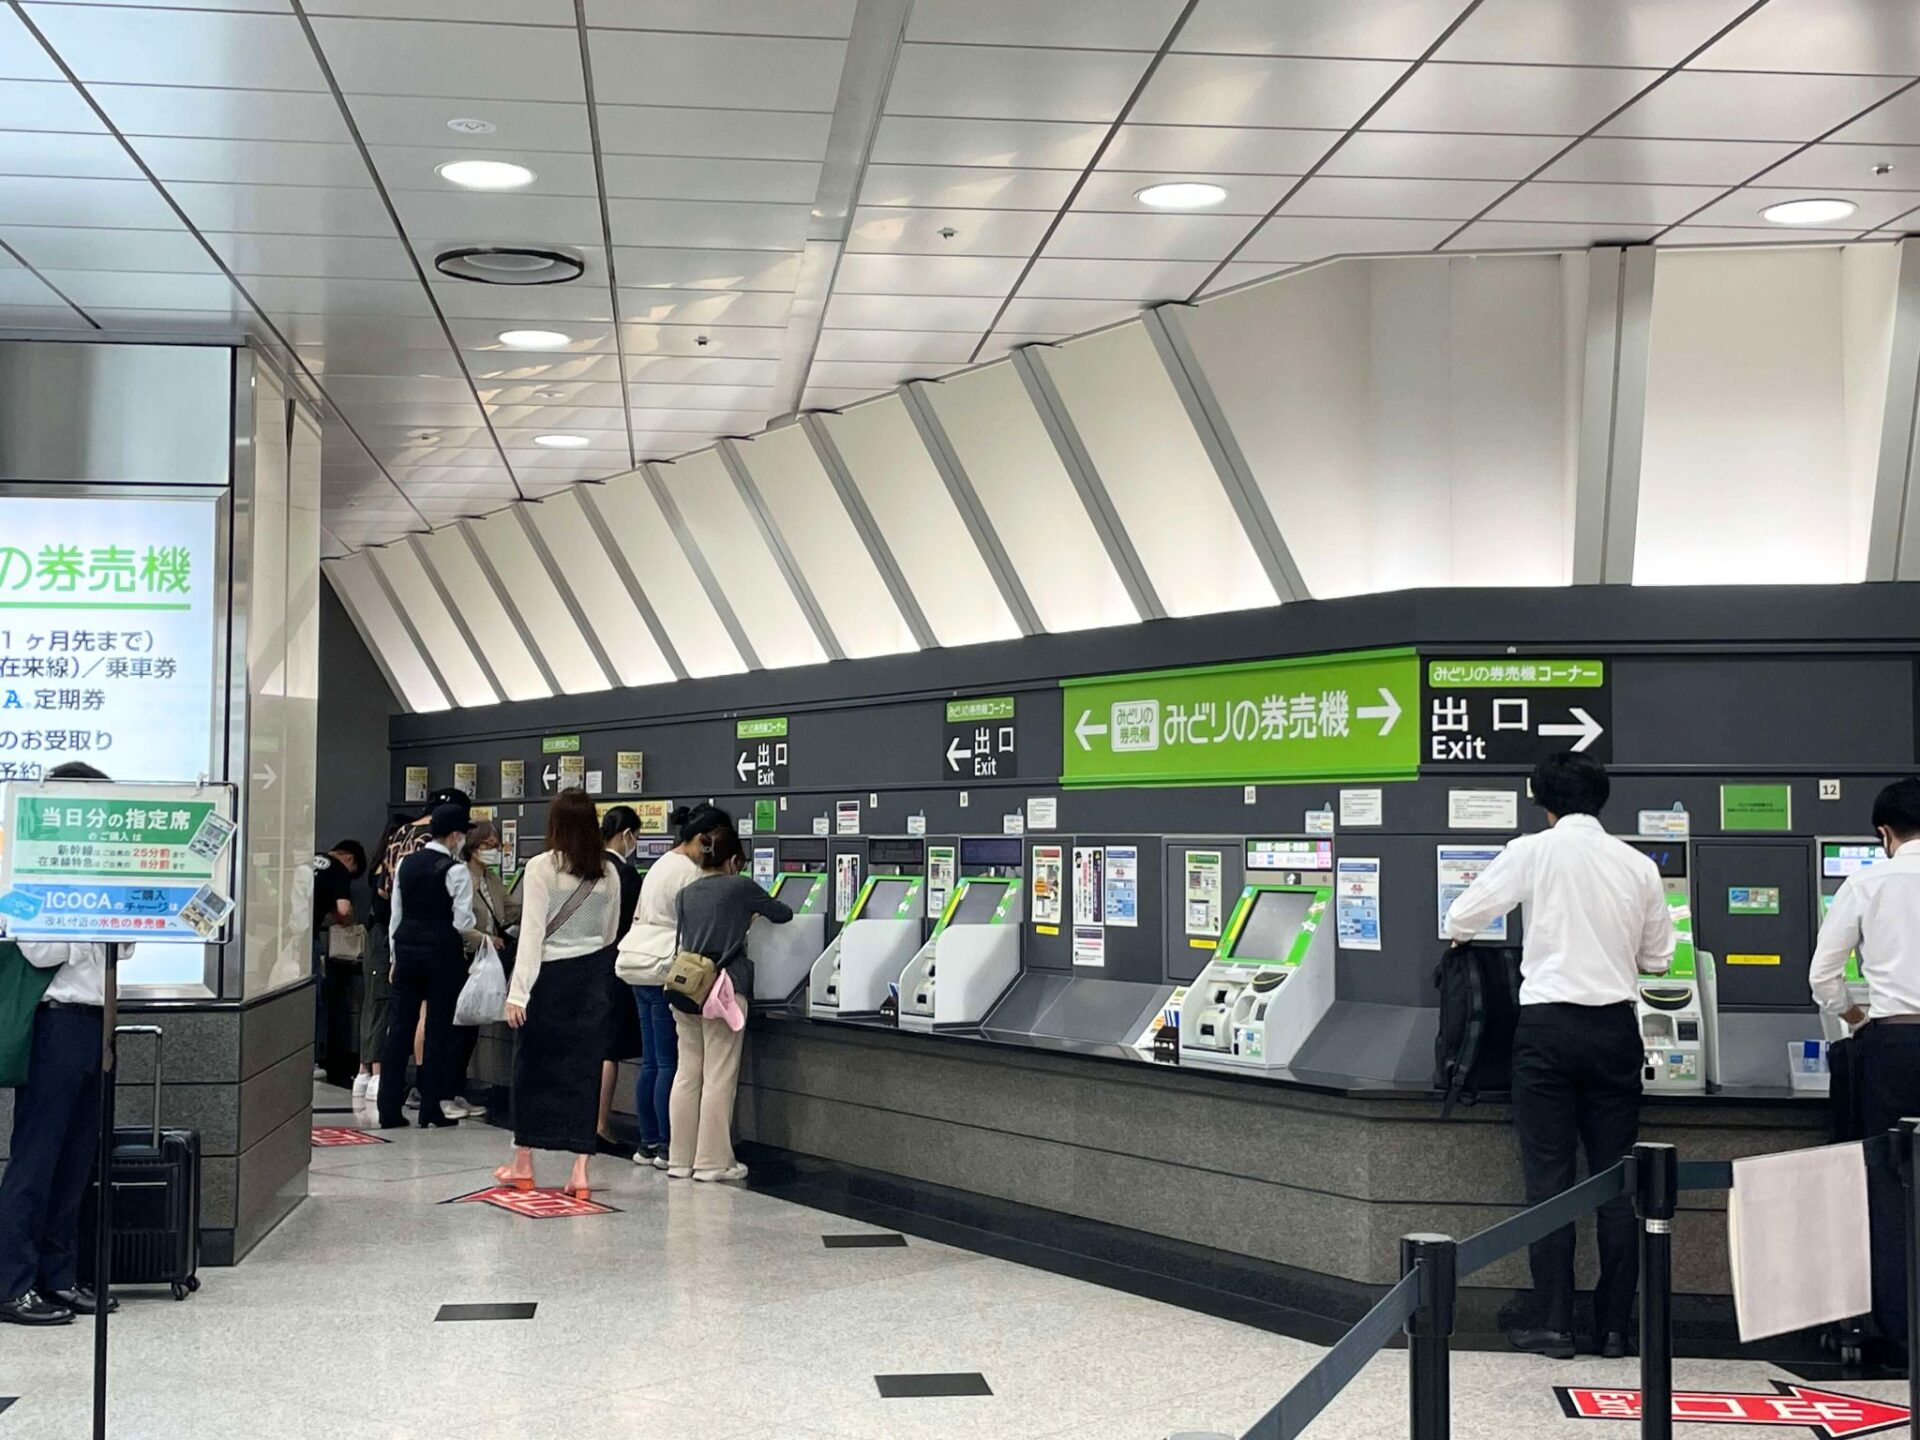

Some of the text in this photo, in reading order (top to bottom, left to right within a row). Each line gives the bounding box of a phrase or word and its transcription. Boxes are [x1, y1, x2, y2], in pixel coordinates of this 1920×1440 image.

[0, 543, 192, 593] の券売機
[1433, 664, 1598, 682] みどりの券売機コーナー
[1116, 706, 1153, 727] みどりの
[1163, 689, 1350, 745] みどりの券売機
[1431, 697, 1529, 732] 出口
[0, 729, 113, 751] のお受取り
[974, 727, 1014, 754] 出口
[1120, 724, 1151, 744] 券売機
[757, 742, 788, 767] 出口
[1431, 735, 1487, 759] Exit
[757, 768, 775, 785] Exit
[974, 756, 997, 776] Exit
[1822, 784, 1837, 796] 12
[42, 807, 191, 830] 当日分の指定席
